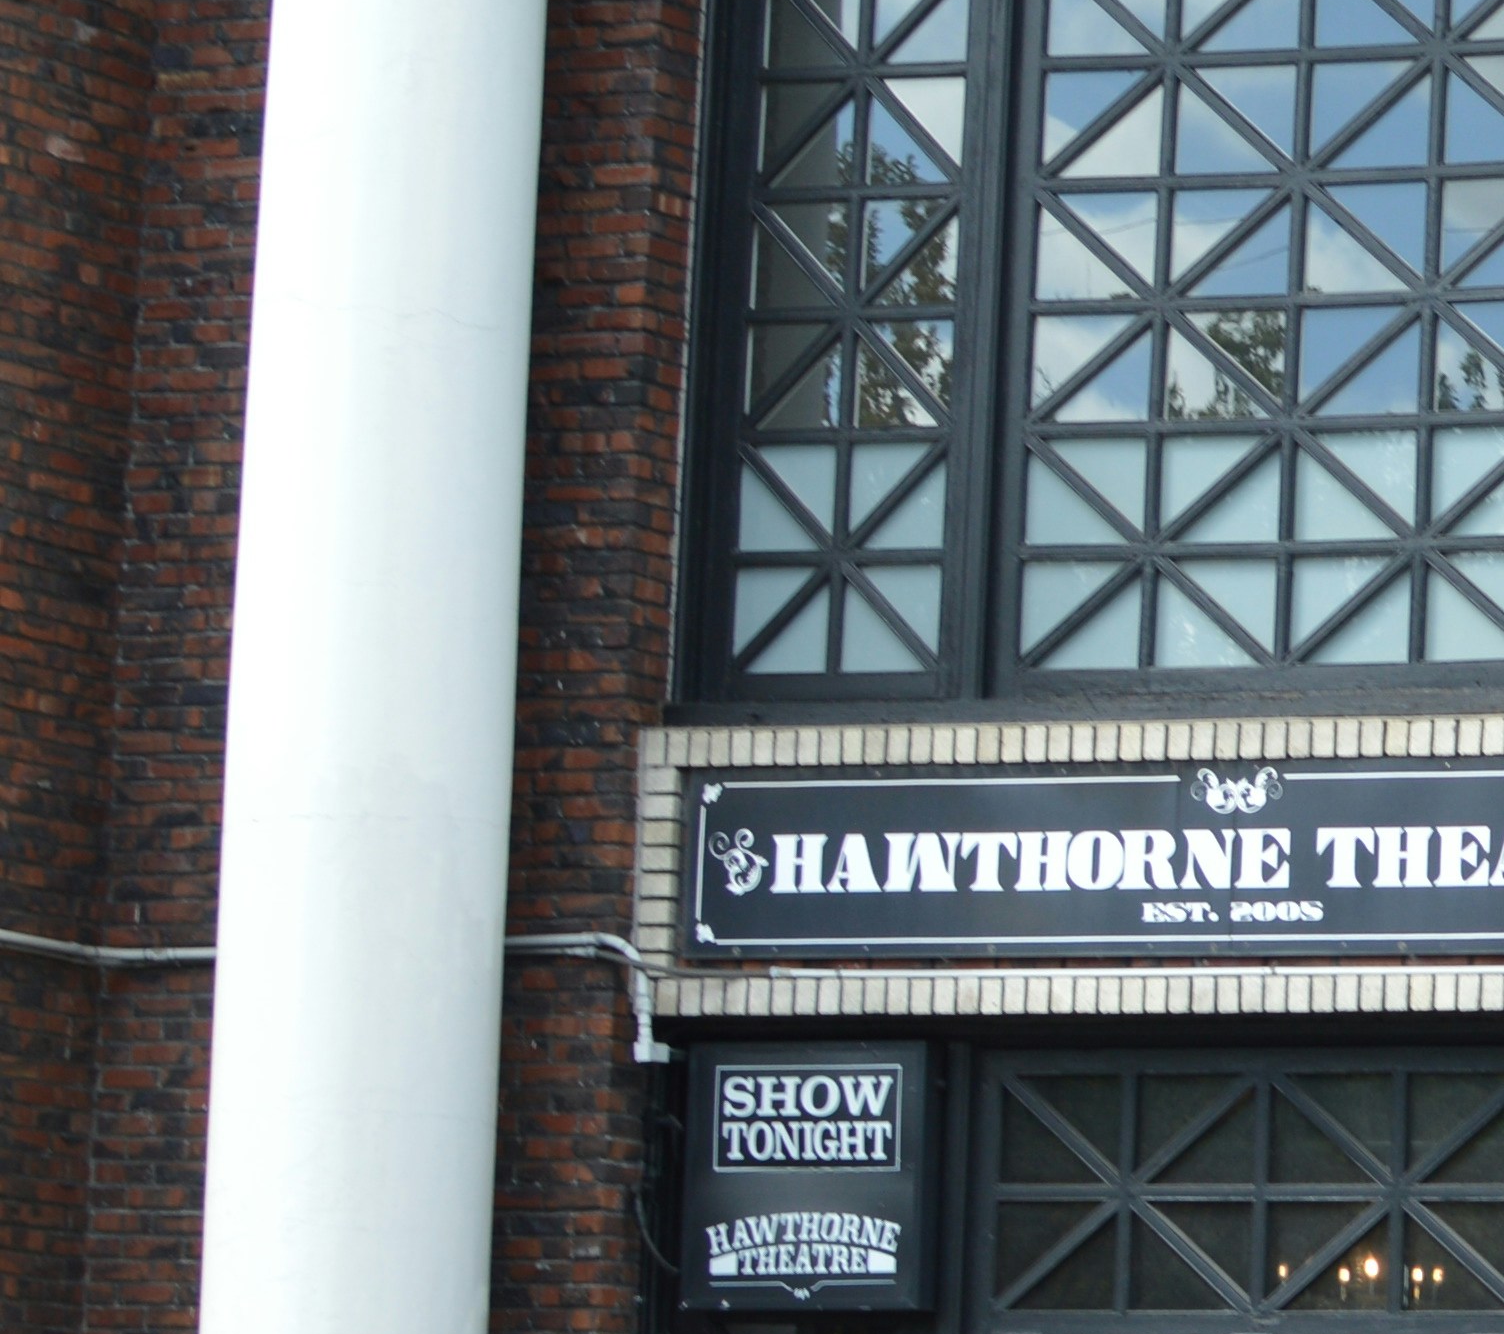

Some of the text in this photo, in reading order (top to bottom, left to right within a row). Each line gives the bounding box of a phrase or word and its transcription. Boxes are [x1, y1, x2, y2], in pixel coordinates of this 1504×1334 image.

[771, 828, 1291, 893] HAWTHORNE
[1142, 901, 1323, 922] EST. 2005
[724, 1076, 893, 1117] SHOW
[723, 1121, 892, 1160] TONIGHT
[707, 1212, 900, 1254] HAWTHORNE
[738, 1243, 868, 1275] THEATRE
